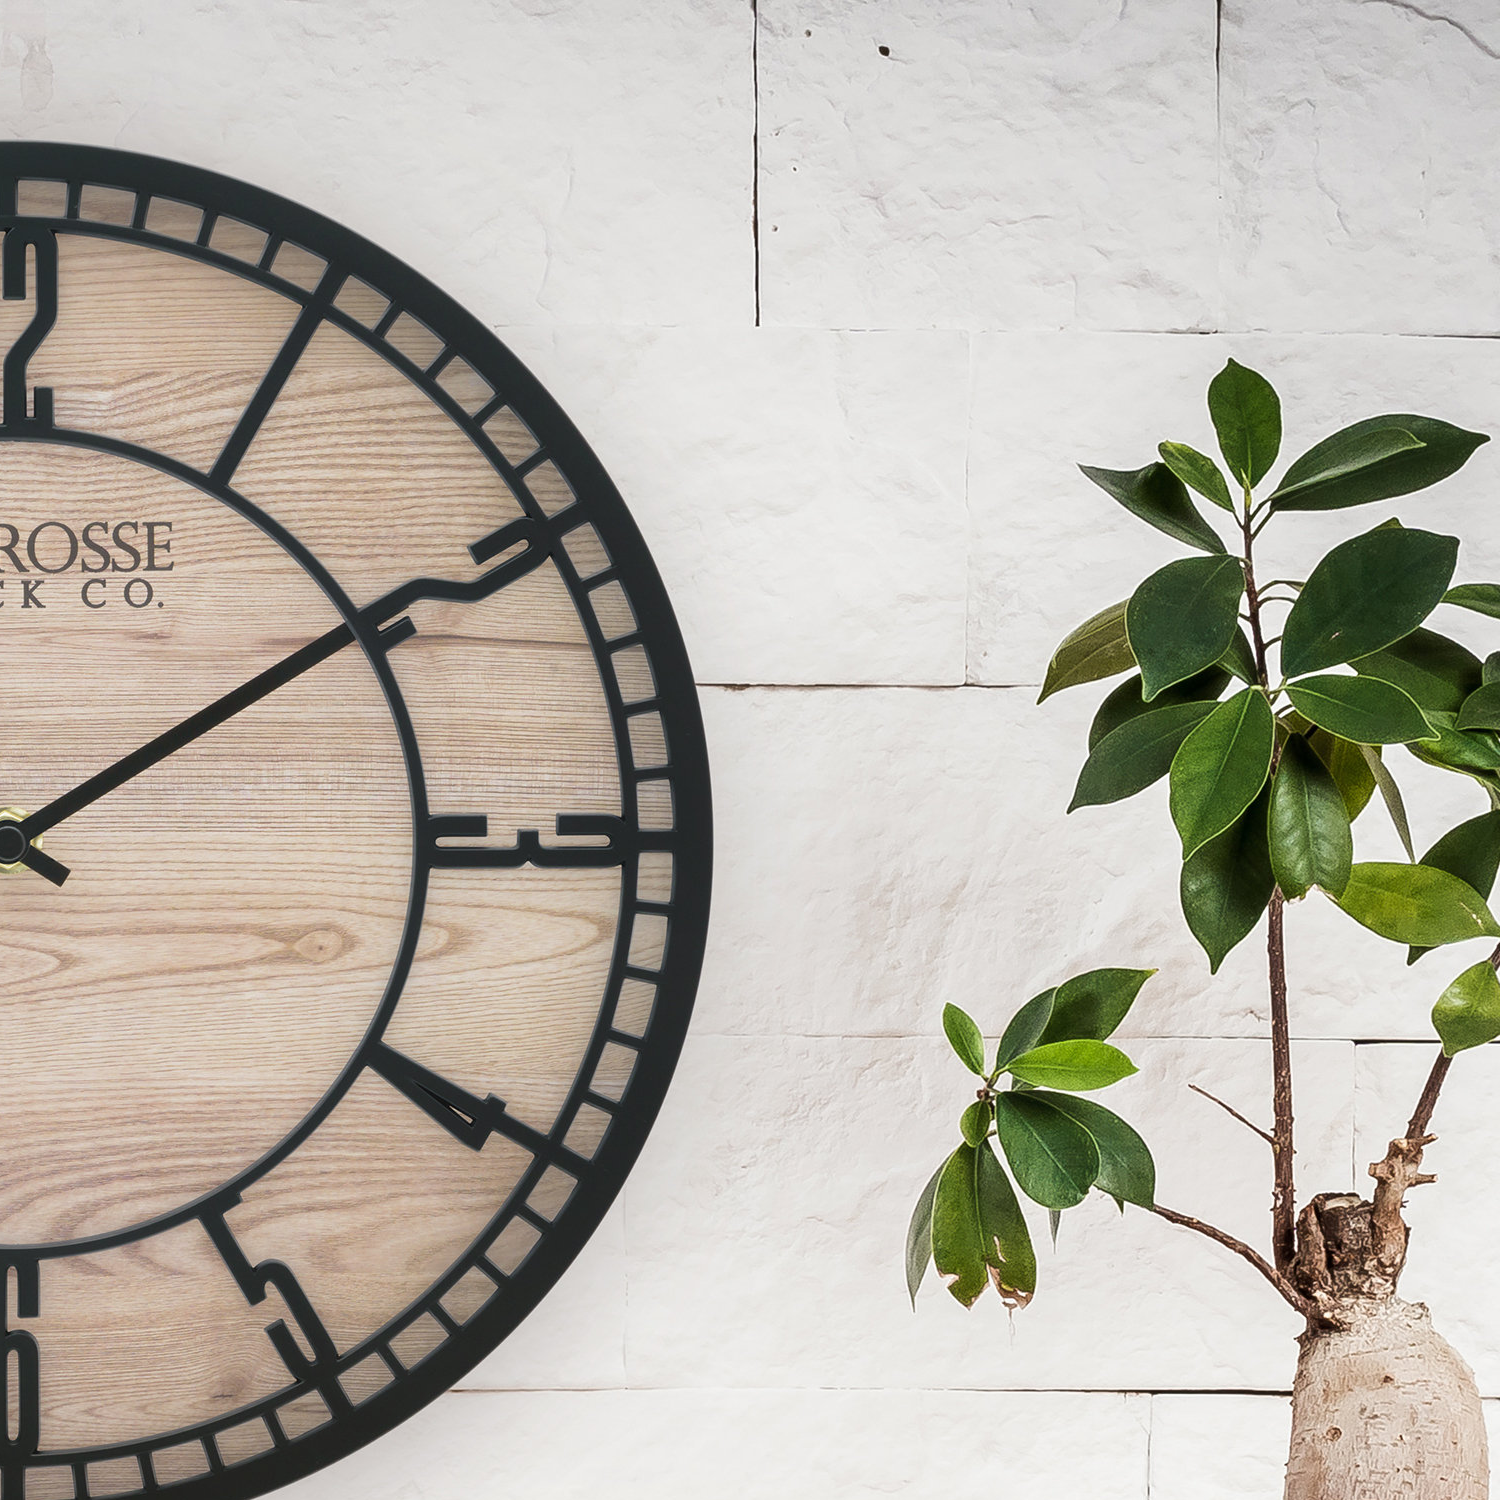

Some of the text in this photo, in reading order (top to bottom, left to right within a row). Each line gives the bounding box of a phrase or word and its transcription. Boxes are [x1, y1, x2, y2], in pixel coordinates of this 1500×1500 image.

[80, 577, 165, 609] CO.
[354, 516, 554, 657] 2
[426, 812, 625, 869] 3
[366, 1040, 550, 1157] 4
[197, 1192, 341, 1385] 5
